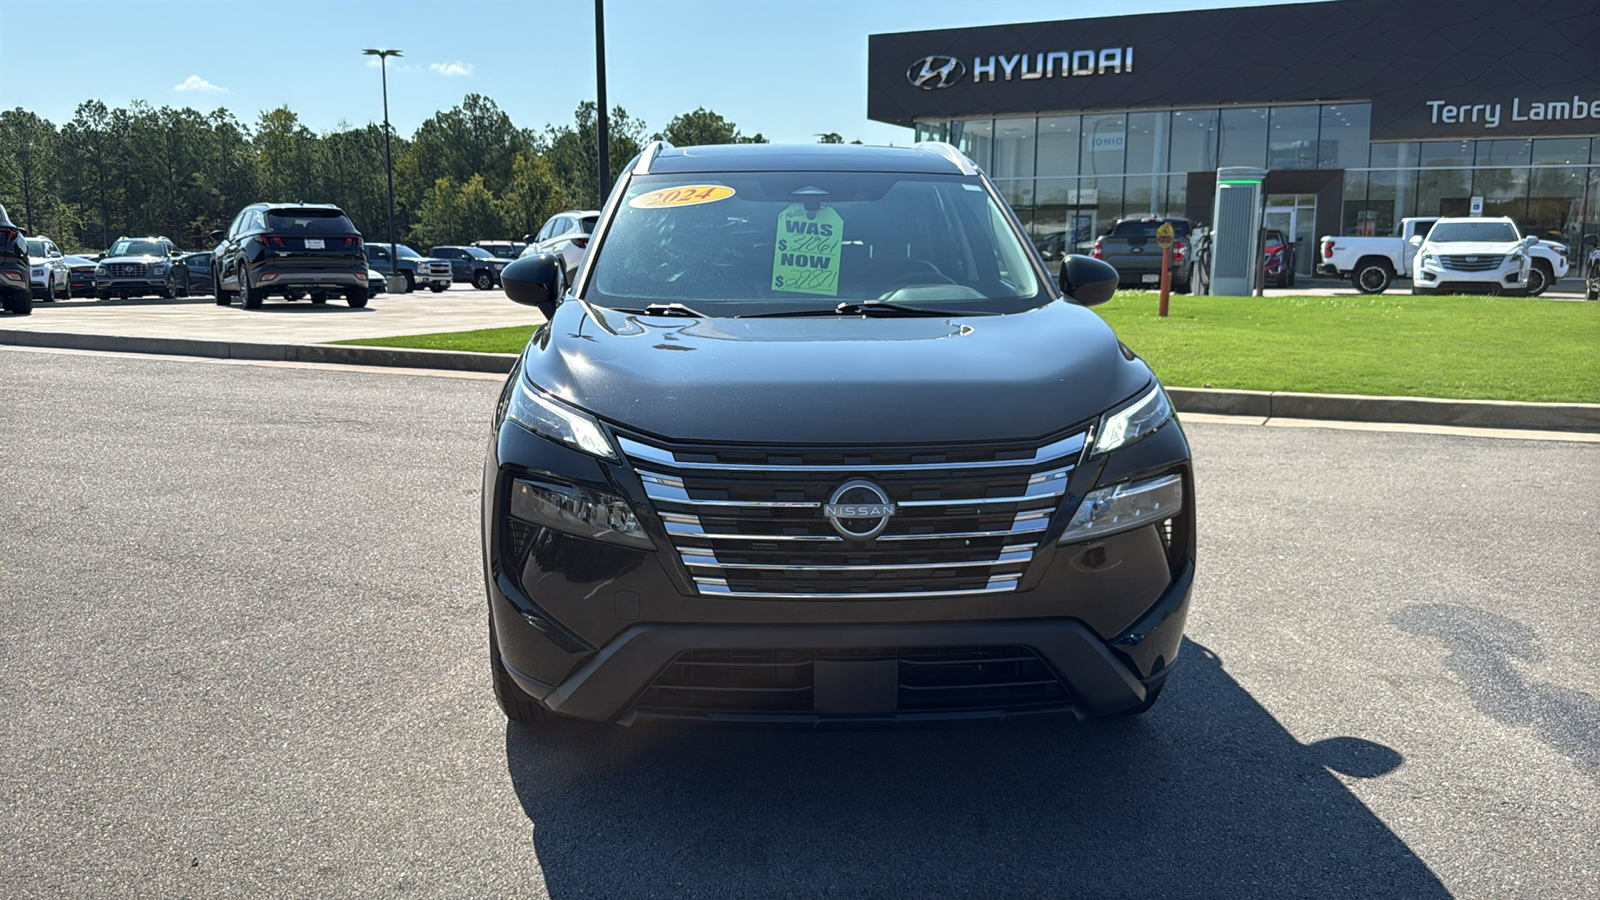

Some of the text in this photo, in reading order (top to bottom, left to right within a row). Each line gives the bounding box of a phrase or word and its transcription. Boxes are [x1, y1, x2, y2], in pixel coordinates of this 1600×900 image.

[973, 46, 1134, 82] HYUNDAI
[1426, 95, 1600, 128] Terry Lambe
[646, 187, 716, 205] 2024
[785, 220, 833, 237] WAS
[780, 252, 831, 269] NOW
[826, 506, 893, 516] NISSAN
